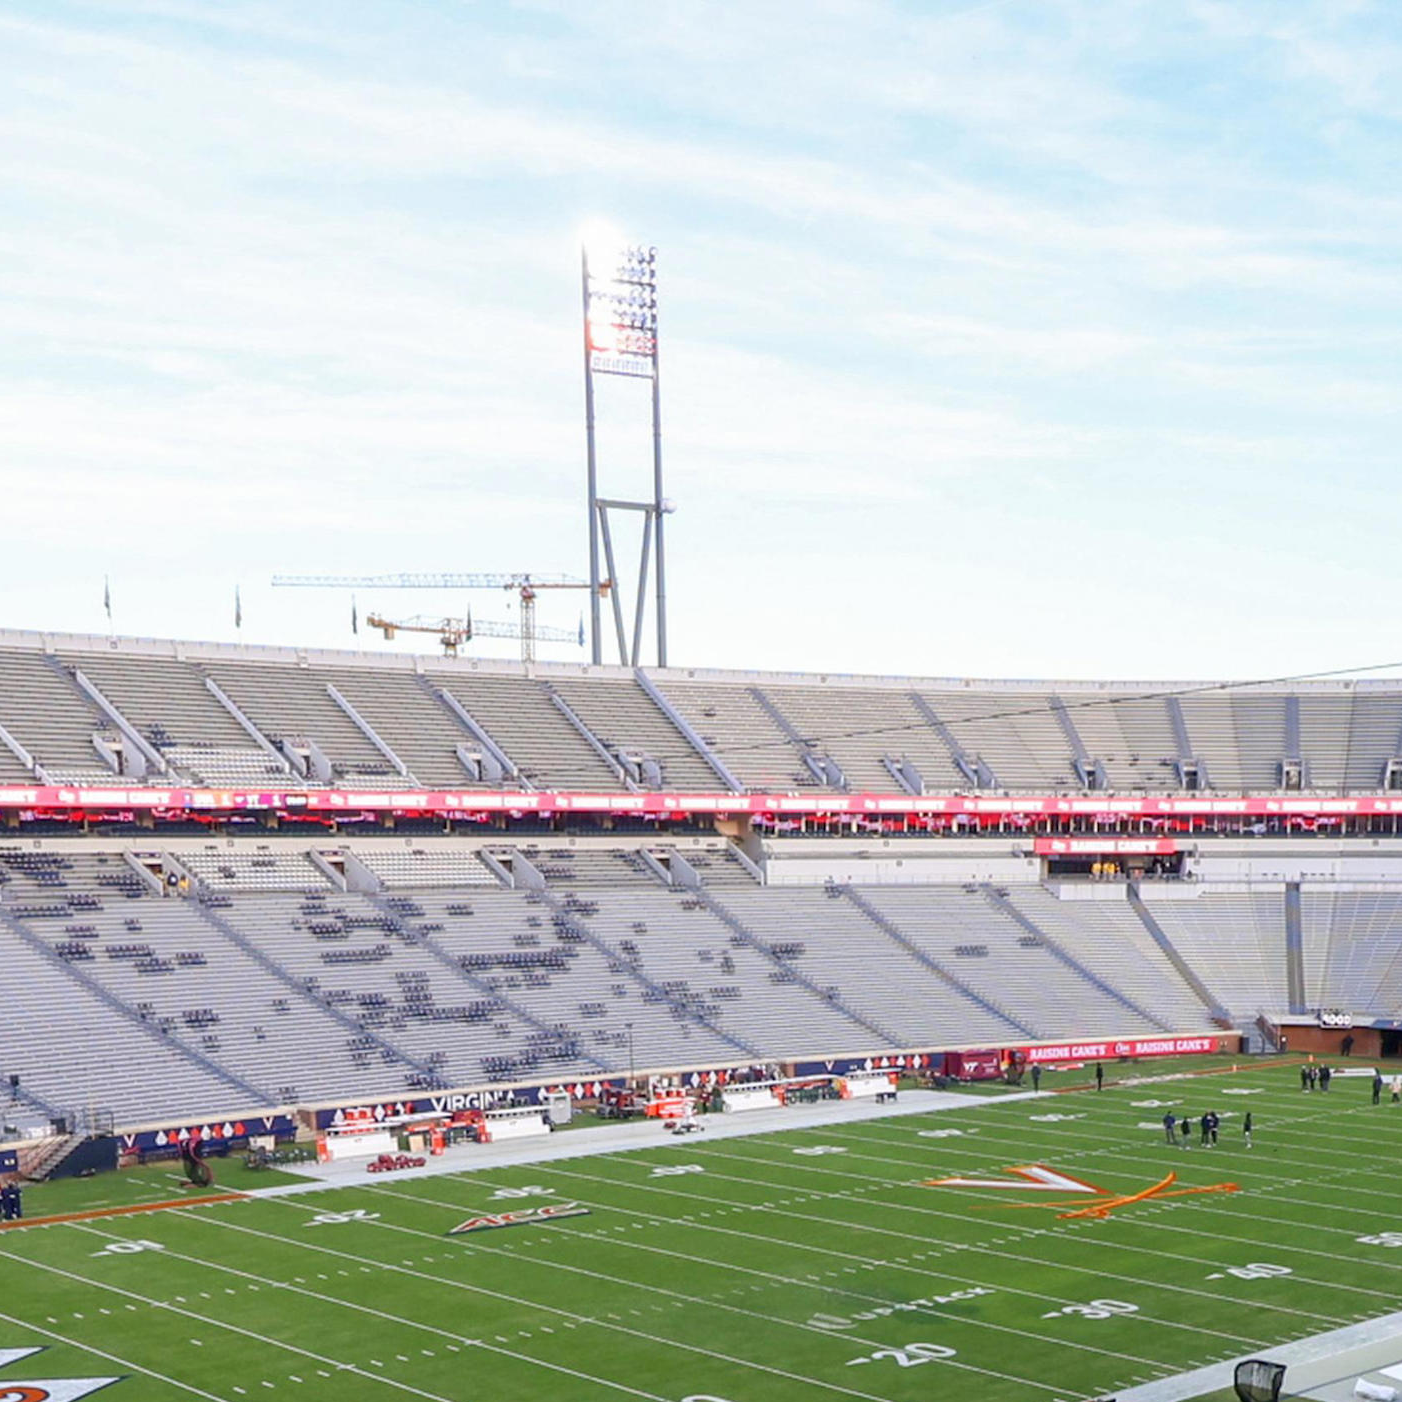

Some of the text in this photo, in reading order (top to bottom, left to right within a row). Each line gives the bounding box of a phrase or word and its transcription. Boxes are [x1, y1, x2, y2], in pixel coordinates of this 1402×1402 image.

[1028, 1047, 1070, 1060] RAISING
[1071, 1045, 1107, 1056] CANE'S
[1135, 1041, 1175, 1054] RAISING
[1177, 1039, 1211, 1051] CANE'S
[450, 1200, 588, 1234] ACC
[1226, 1262, 1293, 1280] 40
[1061, 1299, 1140, 1320] 30
[871, 1342, 957, 1368] 20
